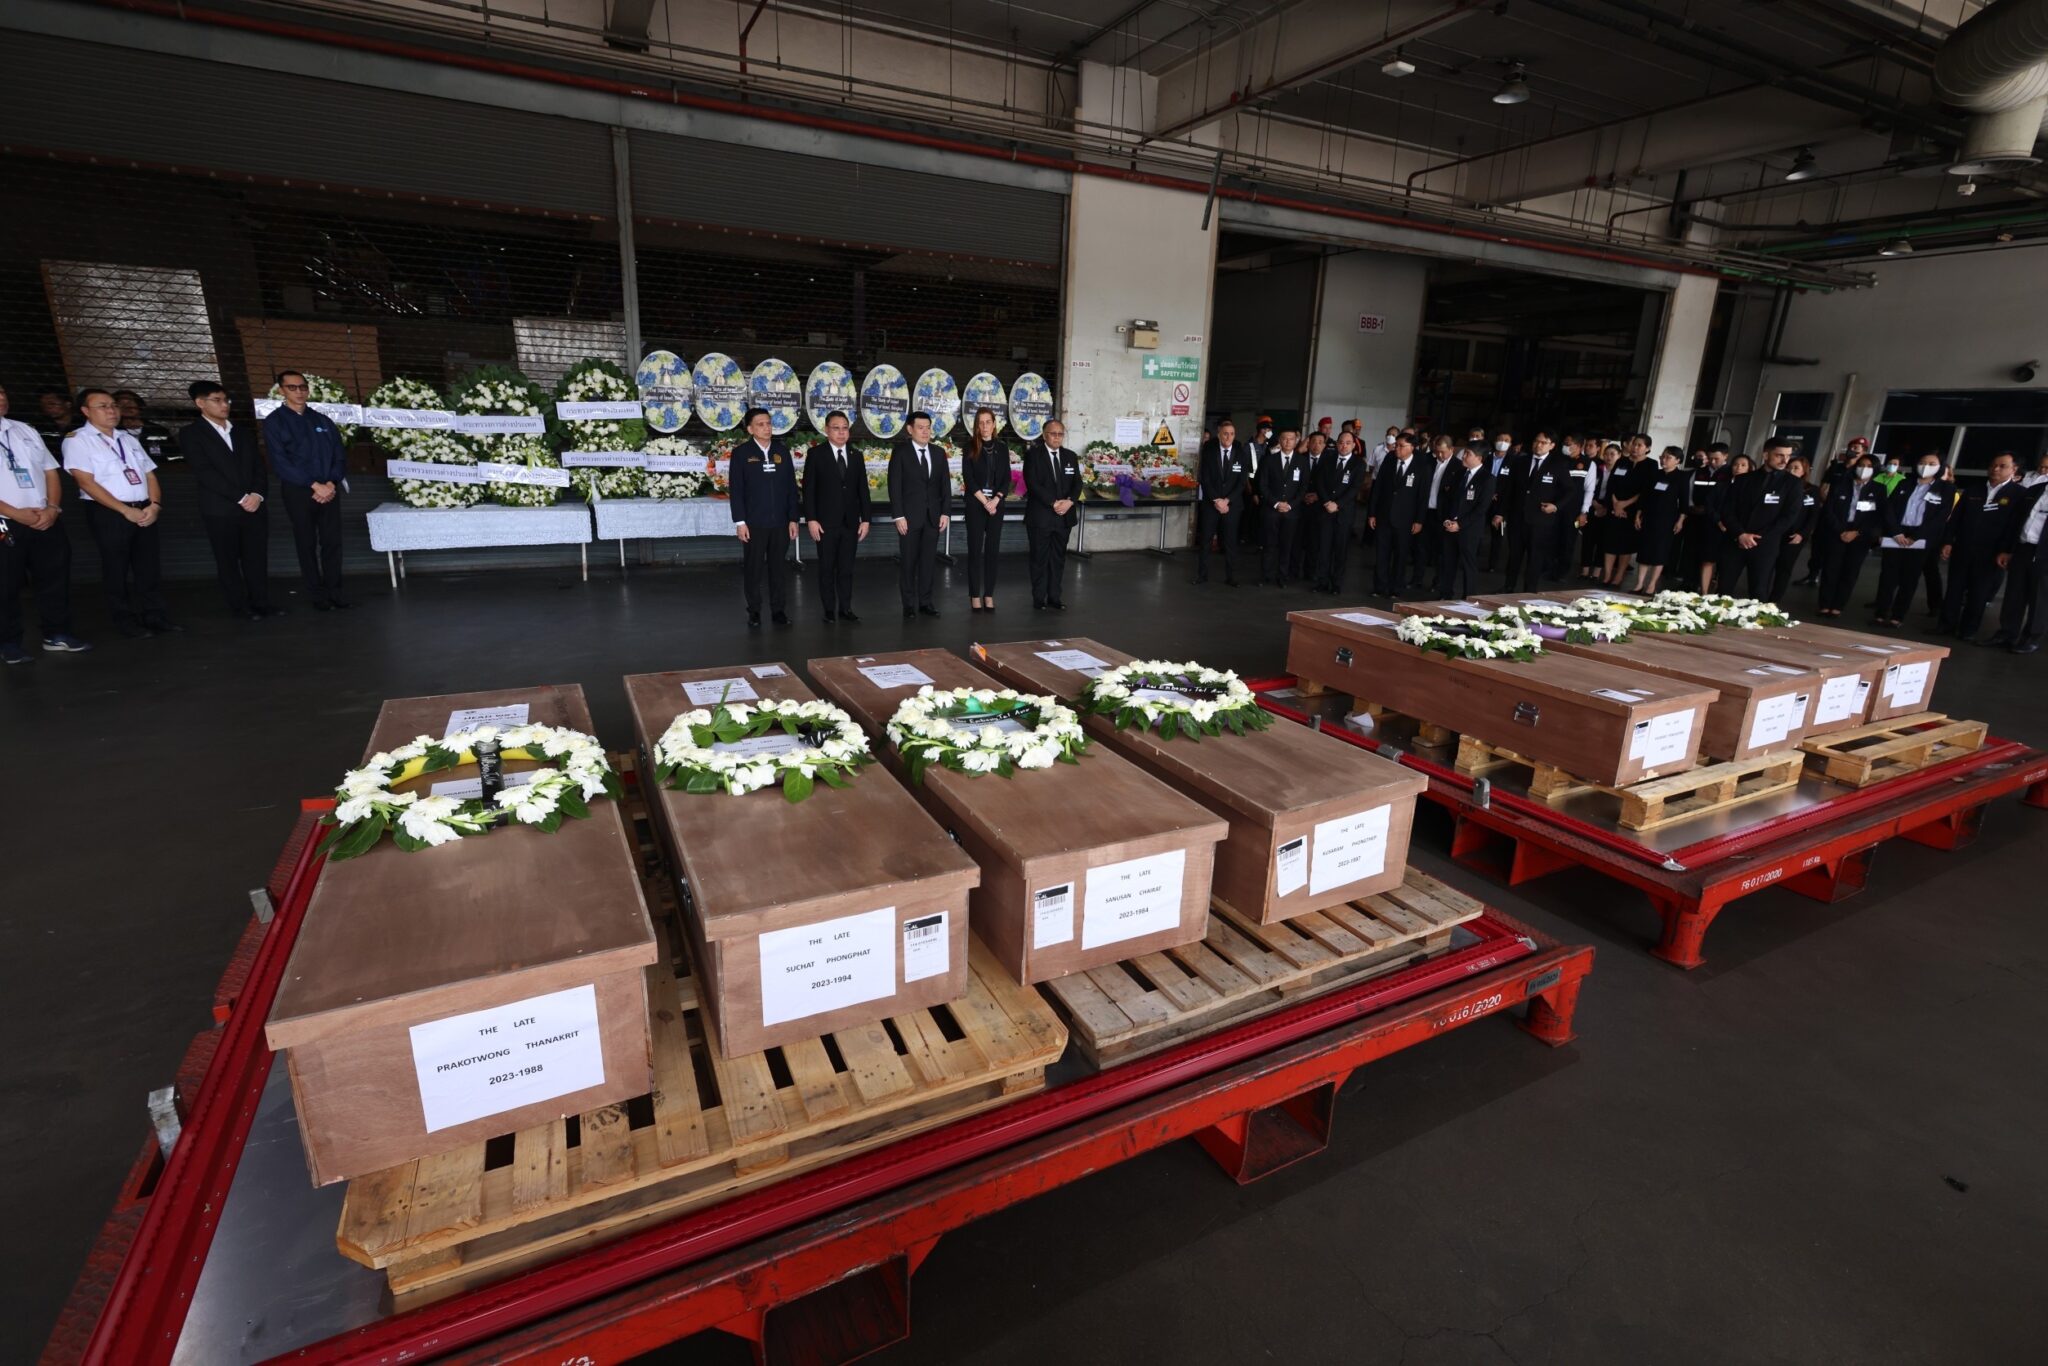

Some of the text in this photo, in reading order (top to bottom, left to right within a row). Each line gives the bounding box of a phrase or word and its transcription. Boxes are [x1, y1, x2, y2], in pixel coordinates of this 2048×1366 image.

[1361, 316, 1384, 330] BBB-1
[1121, 869, 1152, 881] THE LATE
[1106, 893, 1132, 904] SANUSAN
[1118, 907, 1149, 920] 2023-1984
[808, 931, 850, 946] THE LATE
[786, 949, 871, 973] SUCHAT PHONGPHAT
[811, 974, 852, 990] 2023-1994
[478, 1017, 536, 1036] THE LATE
[436, 1030, 580, 1073] PRAKOTWONG THANAKRIT
[488, 1064, 543, 1085] 2023-1988
